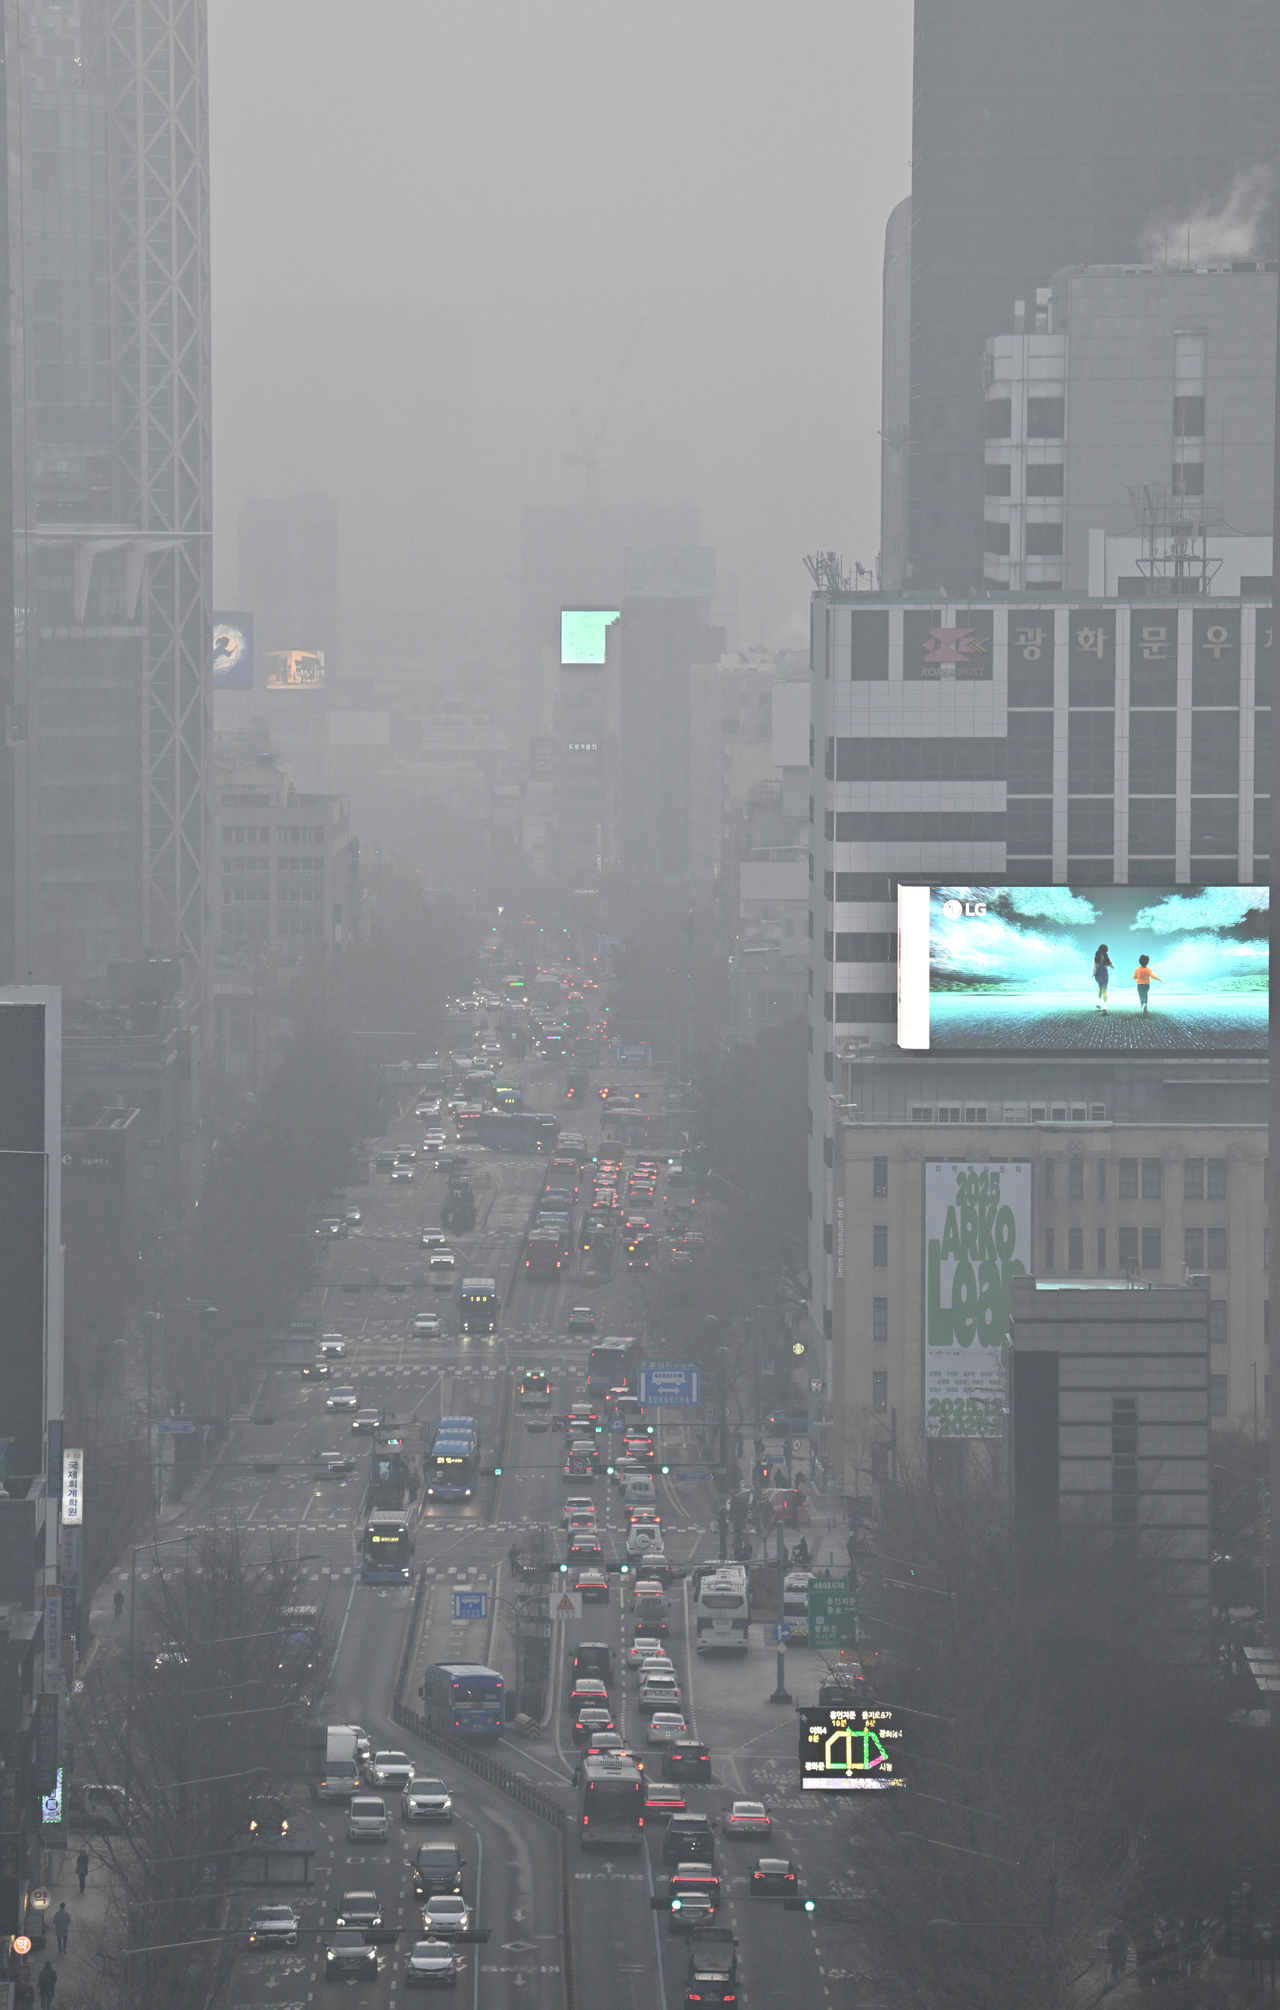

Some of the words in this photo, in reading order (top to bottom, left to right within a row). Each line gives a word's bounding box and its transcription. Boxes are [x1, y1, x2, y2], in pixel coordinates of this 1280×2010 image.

[958, 667, 985, 677] POST
[965, 902, 987, 917] LG
[956, 1170, 1001, 1207] 2025
[836, 1209, 844, 1219] of
[940, 1204, 1016, 1261] ARKO
[573, 1461, 583, 1470] 50
[67, 1461, 78, 1517] 국제회계학원
[813, 1581, 845, 1590] 세종대로사거리
[827, 1597, 856, 1606] 흥인지문
[827, 1606, 842, 1614] 종로
[34, 1891, 48, 1904] 약
[17, 1939, 28, 1951] 약
